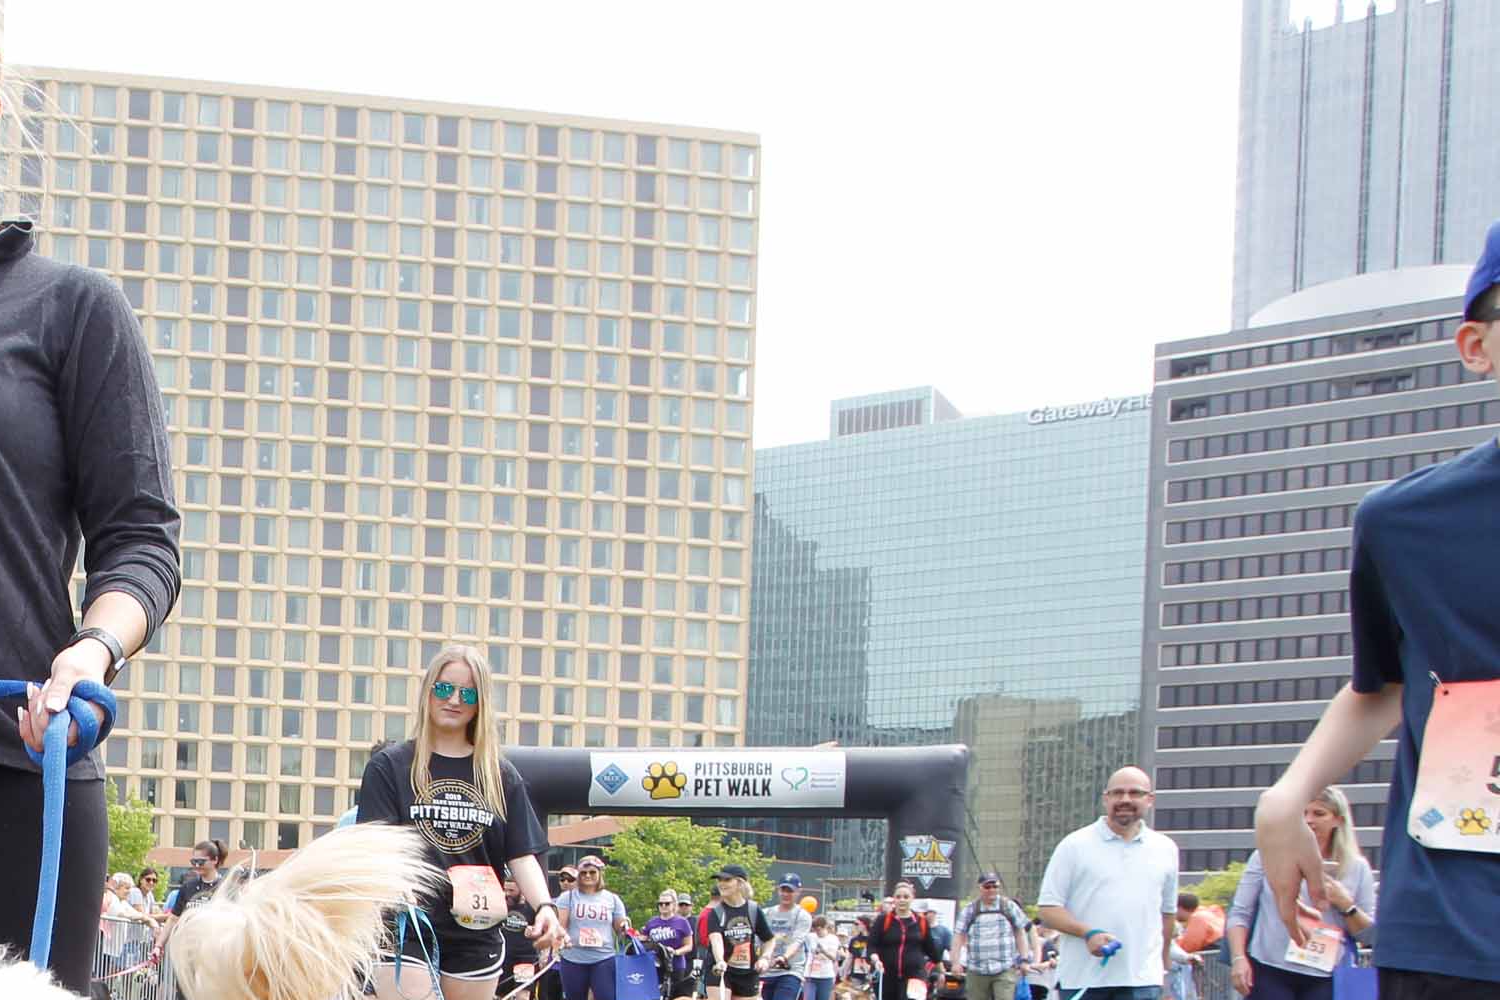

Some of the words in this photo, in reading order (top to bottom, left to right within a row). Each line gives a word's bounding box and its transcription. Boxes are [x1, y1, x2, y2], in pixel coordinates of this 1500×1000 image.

[1028, 398, 1122, 425] Gateway
[694, 762, 773, 777] PITTSBURGH
[693, 778, 721, 797] PET
[728, 778, 772, 797] WALK
[410, 805, 494, 827] PITTSBURGH
[433, 820, 448, 829] PET
[449, 821, 475, 831] WALK
[472, 894, 489, 910] 31
[576, 903, 608, 921] USA
